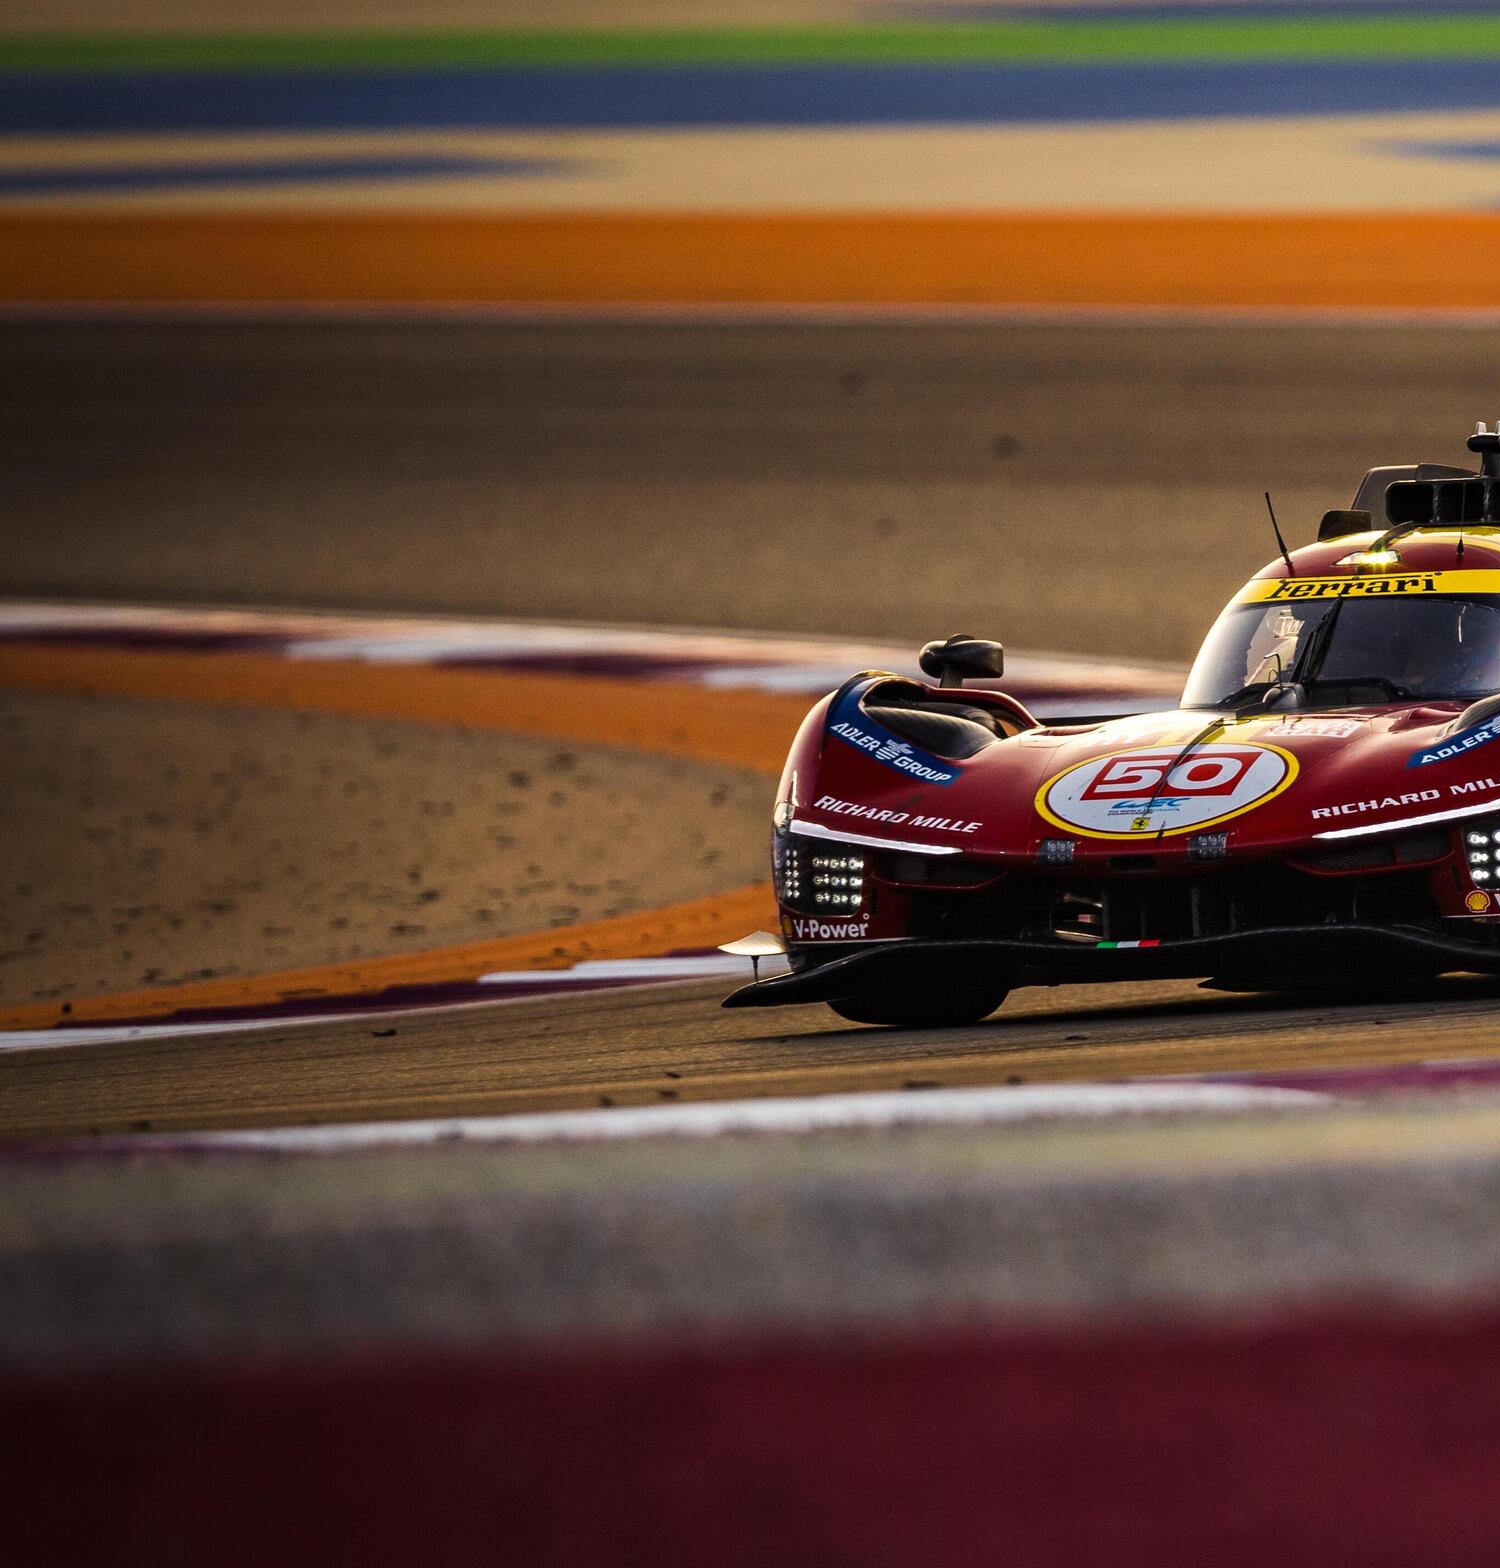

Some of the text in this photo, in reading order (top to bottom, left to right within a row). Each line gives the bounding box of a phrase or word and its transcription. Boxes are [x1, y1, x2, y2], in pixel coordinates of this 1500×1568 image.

[1265, 575, 1437, 599] Ferrari
[830, 722, 952, 781] ADLER GROUP
[1421, 731, 1492, 764] ADLER
[1093, 757, 1243, 793] 50
[813, 795, 983, 833] RICHARD MILLE
[1311, 789, 1441, 819] RICHARD
[793, 919, 869, 938] V-Power
